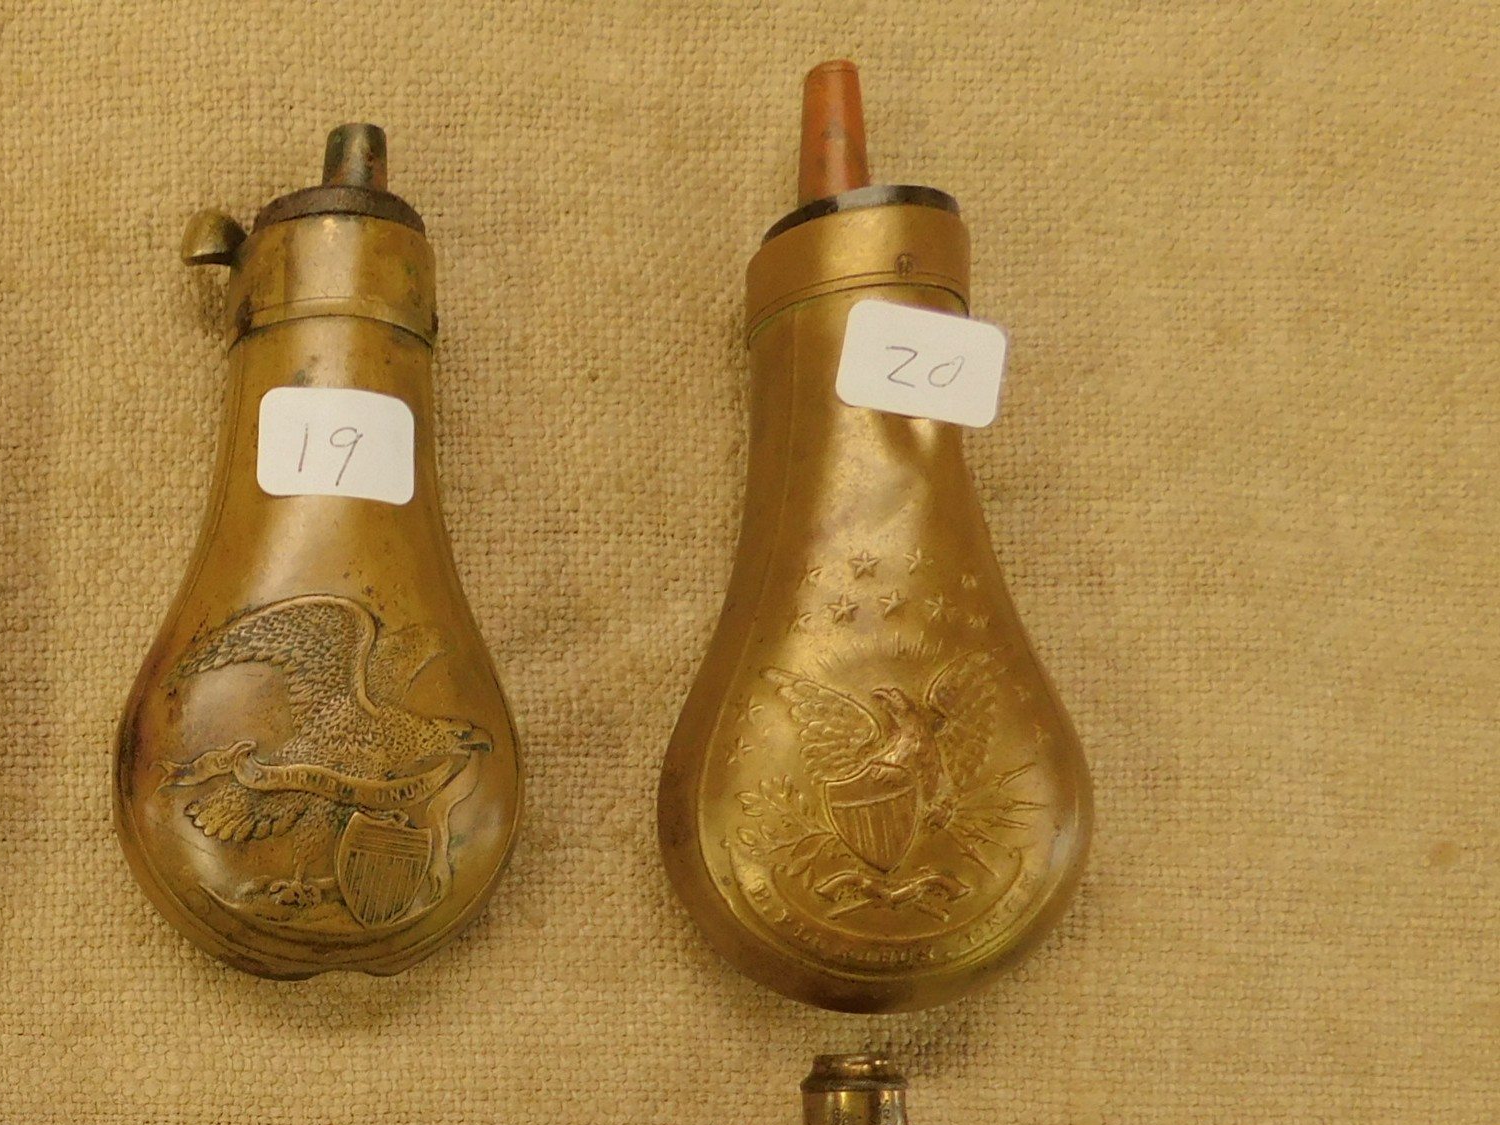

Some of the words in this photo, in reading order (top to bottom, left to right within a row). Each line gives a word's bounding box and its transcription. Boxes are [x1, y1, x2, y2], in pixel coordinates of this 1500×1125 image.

[885, 345, 966, 389] 20
[297, 425, 364, 487] 19
[252, 768, 367, 801] PLURIBUS
